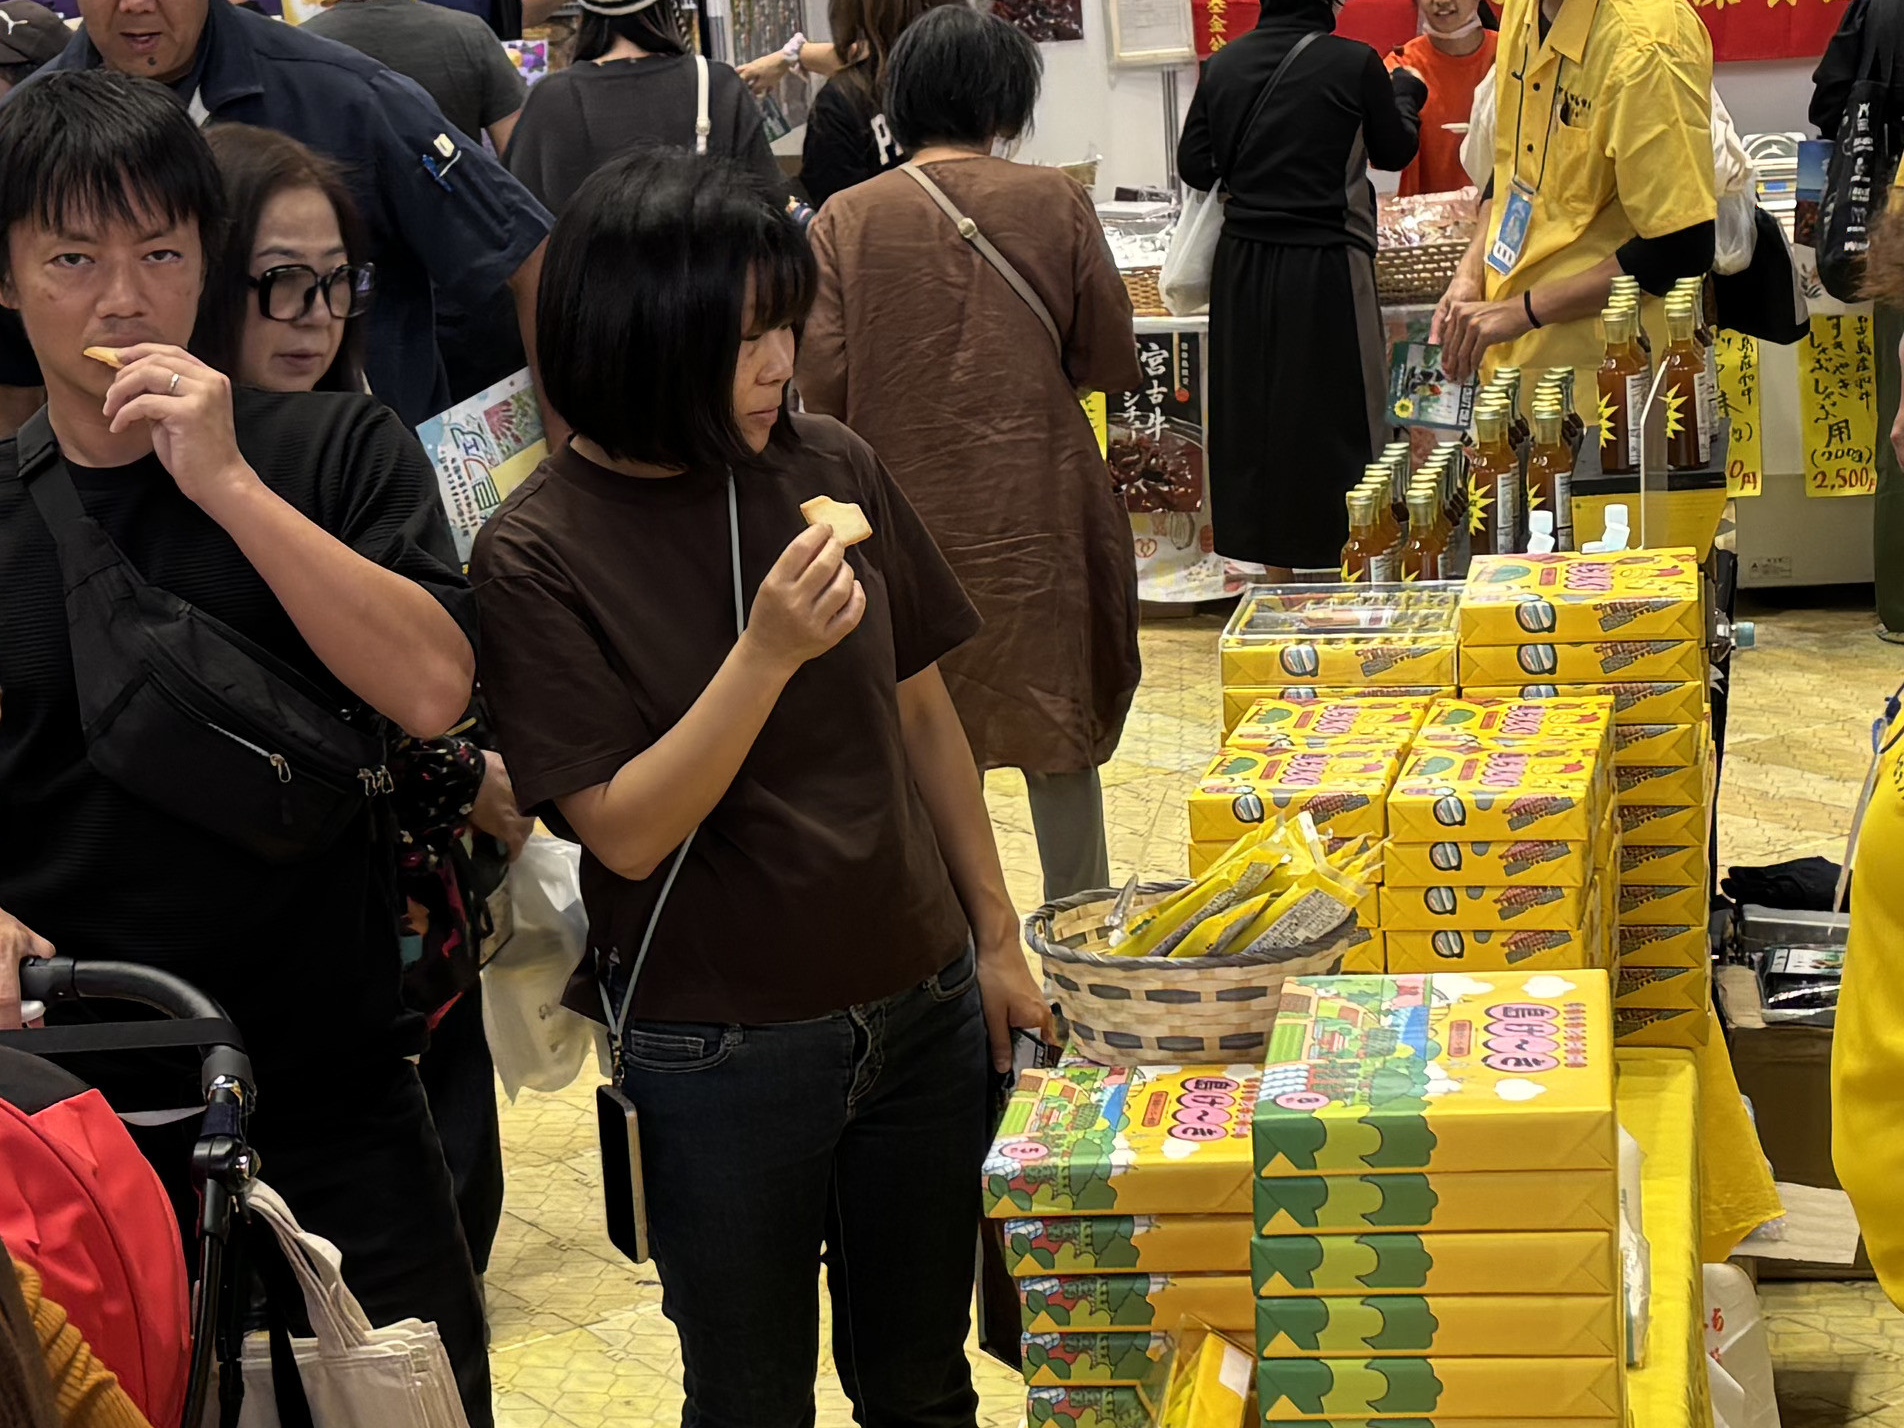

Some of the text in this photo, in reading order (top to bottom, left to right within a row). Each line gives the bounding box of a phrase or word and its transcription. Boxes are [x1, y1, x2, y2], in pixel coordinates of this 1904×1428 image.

[1141, 342, 1170, 442] 宮古牛
[1825, 418, 1852, 448] 用
